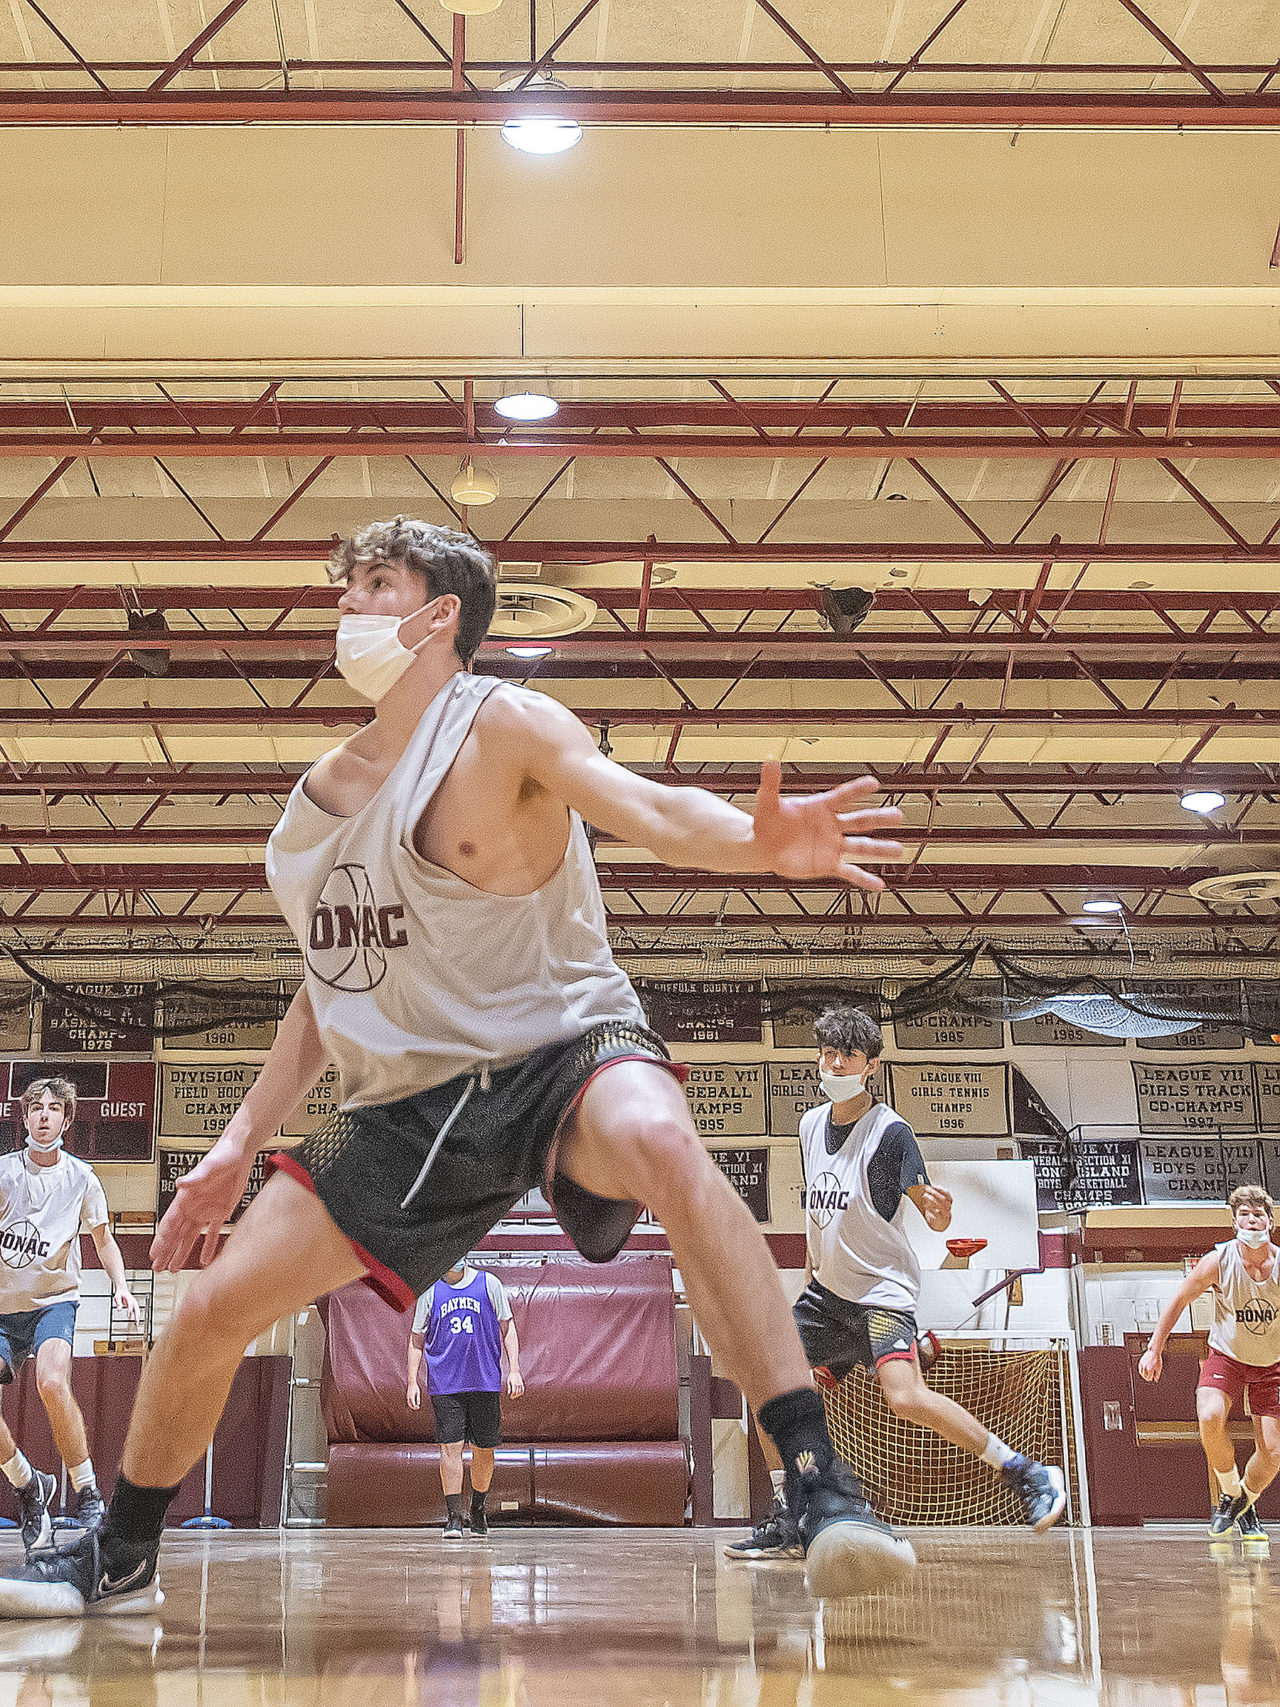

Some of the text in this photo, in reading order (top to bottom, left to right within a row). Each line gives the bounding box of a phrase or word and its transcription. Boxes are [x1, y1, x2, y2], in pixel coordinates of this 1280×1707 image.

[309, 904, 409, 950] ONAC
[81, 1039, 114, 1051] 1978
[170, 1069, 245, 1083] DIVISION
[687, 1069, 759, 1082] GUE VII
[920, 1071, 982, 1083] LEAGUE VIII
[1143, 1068, 1245, 1081] LEAGUE VII
[174, 1086, 209, 1100] FIELD
[686, 1086, 753, 1099] SEBALL
[771, 1084, 805, 1097] GIRLS
[911, 1086, 991, 1098] GIRLS TENNIS
[1139, 1083, 1252, 1097] GIRLS TRACK
[100, 1102, 147, 1118] GUEST
[306, 1103, 339, 1116] CHA
[930, 1102, 973, 1114] CHAMPS
[1149, 1100, 1245, 1113] CO-CHAMPS
[202, 1118, 230, 1132] 199
[939, 1118, 965, 1130] 1996
[1144, 1146, 1216, 1158] LEAGUE
[1152, 1162, 1197, 1175] BOYS
[161, 1179, 175, 1193] BO
[732, 1174, 760, 1186] AND
[1038, 1178, 1063, 1190] BOYS
[1054, 1189, 1113, 1201] CHAMPS
[440, 1295, 482, 1319] BAYMEN
[449, 1315, 475, 1335] 34
